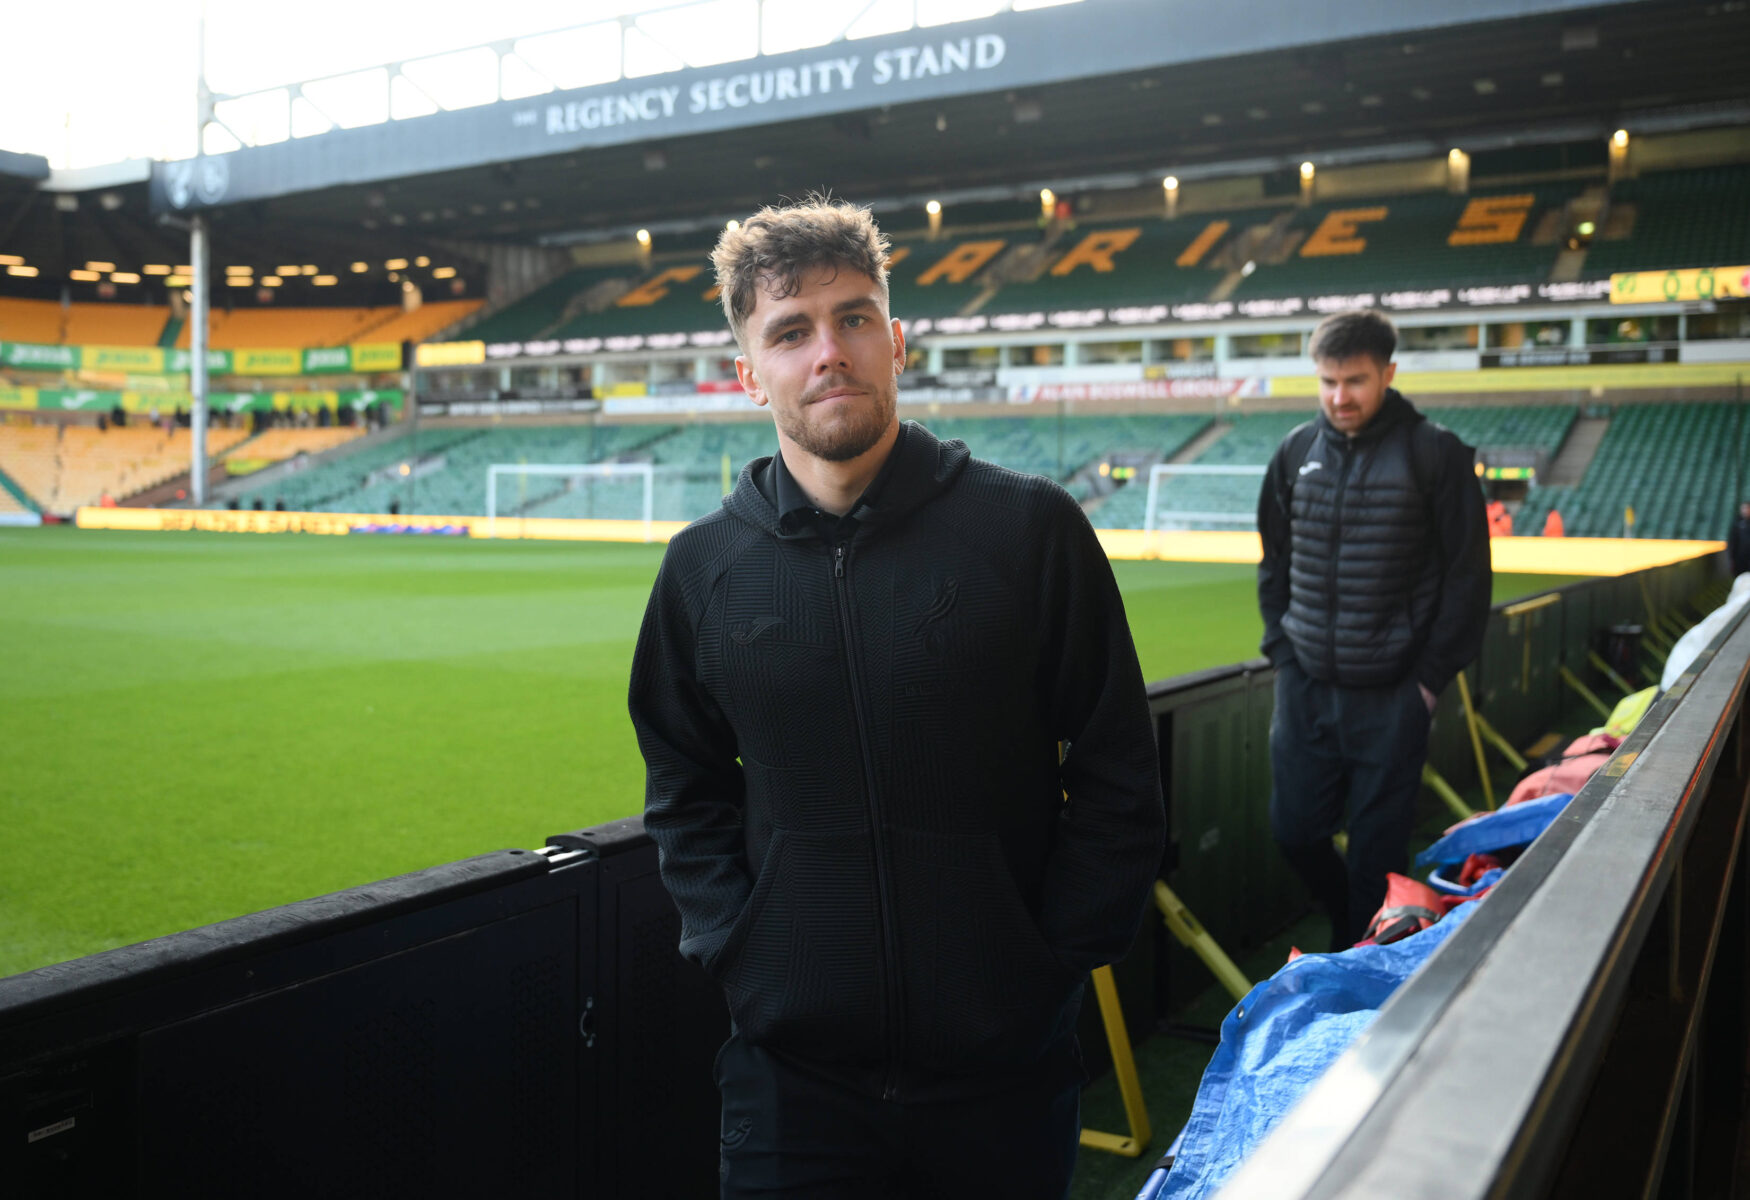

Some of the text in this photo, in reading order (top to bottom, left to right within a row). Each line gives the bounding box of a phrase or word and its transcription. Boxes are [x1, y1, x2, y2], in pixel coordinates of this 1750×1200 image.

[545, 86, 679, 135] REGENCY
[688, 58, 860, 113] SECURITY
[873, 34, 1006, 85] STAND
[1663, 266, 1716, 302] 0 0
[1169, 379, 1236, 398] GROUP
